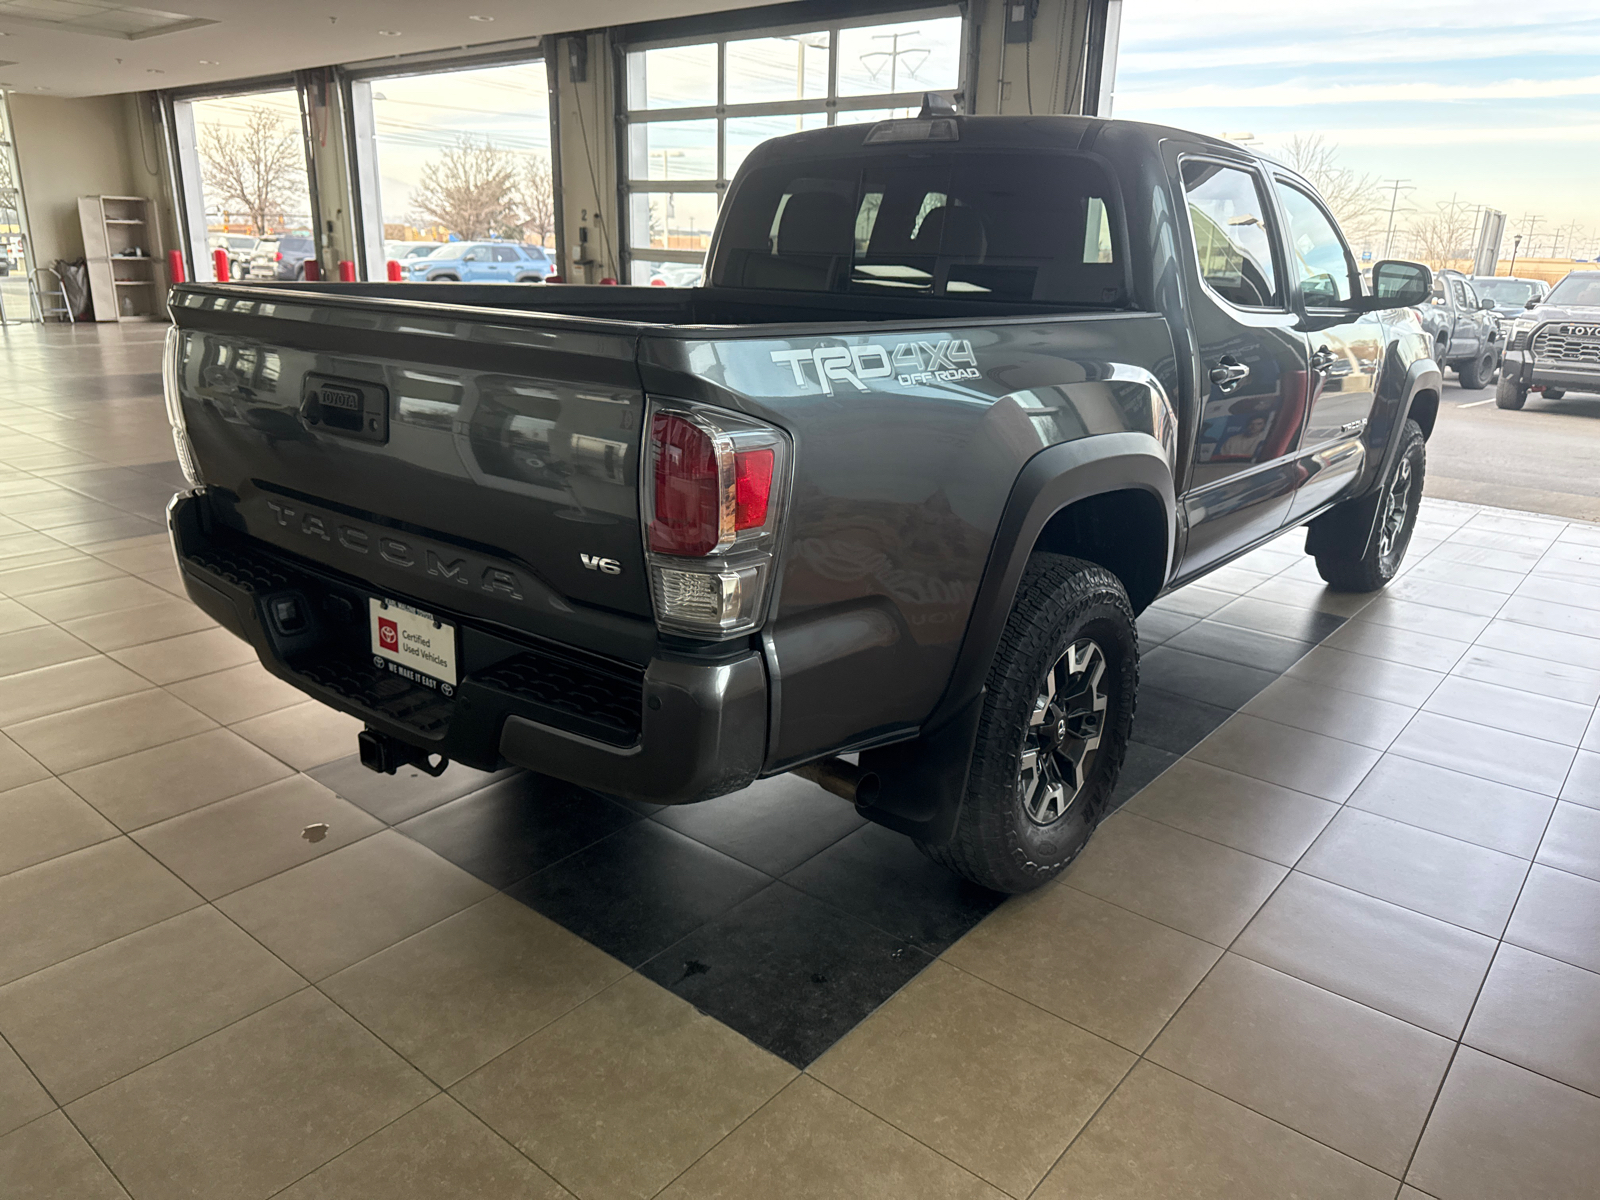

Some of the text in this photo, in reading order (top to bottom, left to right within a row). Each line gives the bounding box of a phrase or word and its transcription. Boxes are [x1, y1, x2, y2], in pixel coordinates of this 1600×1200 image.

[581, 208, 588, 222] 2
[770, 345, 895, 397] TRD
[897, 367, 981, 387] OFF ROAD
[320, 389, 358, 409] TOYOTA
[266, 499, 525, 602] TACOMA
[579, 552, 622, 576] V6
[402, 629, 431, 648] Certified
[402, 642, 448, 668] Used Vehicles
[388, 662, 437, 690] WE MAKE IT EASY
